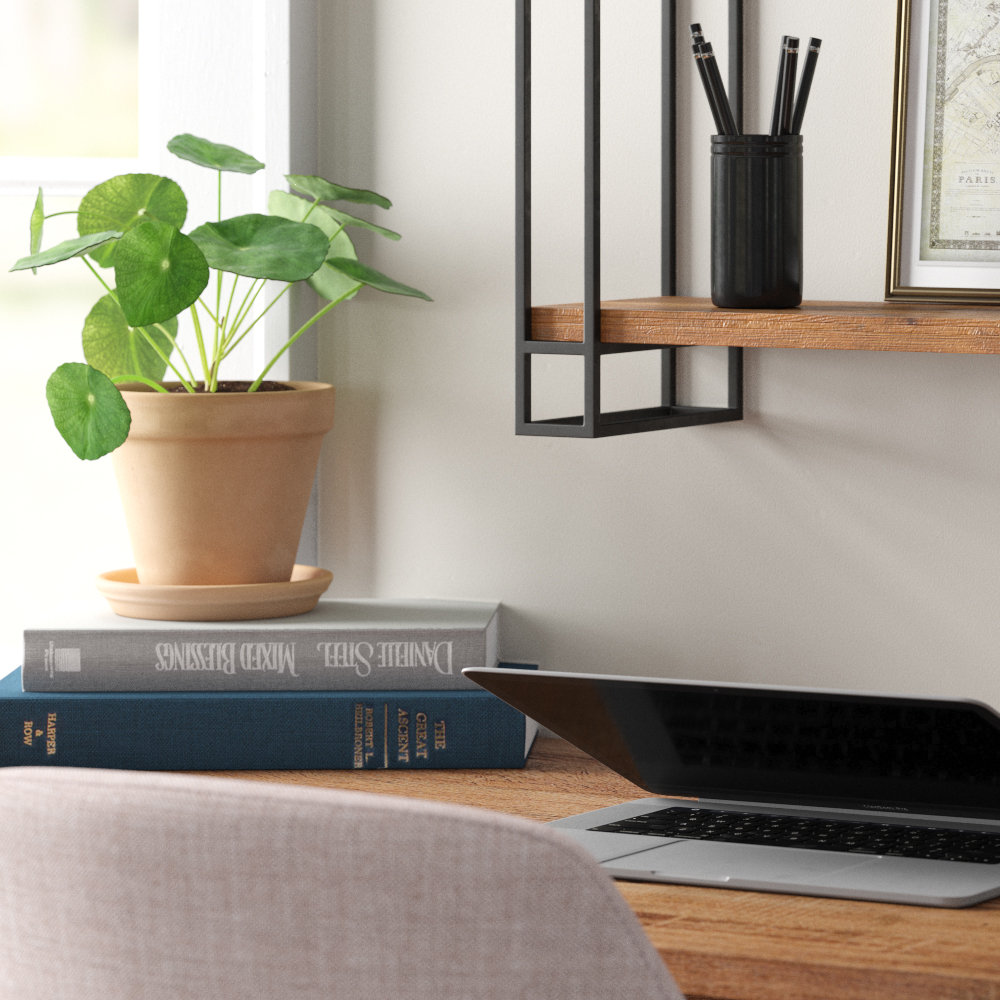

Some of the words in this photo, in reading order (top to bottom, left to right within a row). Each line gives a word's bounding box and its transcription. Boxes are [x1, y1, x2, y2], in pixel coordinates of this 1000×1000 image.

[155, 641, 236, 675] BLESSINGS
[240, 641, 300, 678] MIXED
[316, 640, 374, 678] STEEL
[377, 640, 454, 676] DANIELLE
[23, 720, 33, 747] ROW
[34, 728, 44, 738] &
[47, 712, 57, 756] HARPER
[353, 703, 363, 769] HEILBRONER
[364, 707, 374, 749] ROBERT
[397, 707, 410, 763] ASCENT
[415, 712, 429, 760] GREAT
[433, 720, 446, 750] THE
